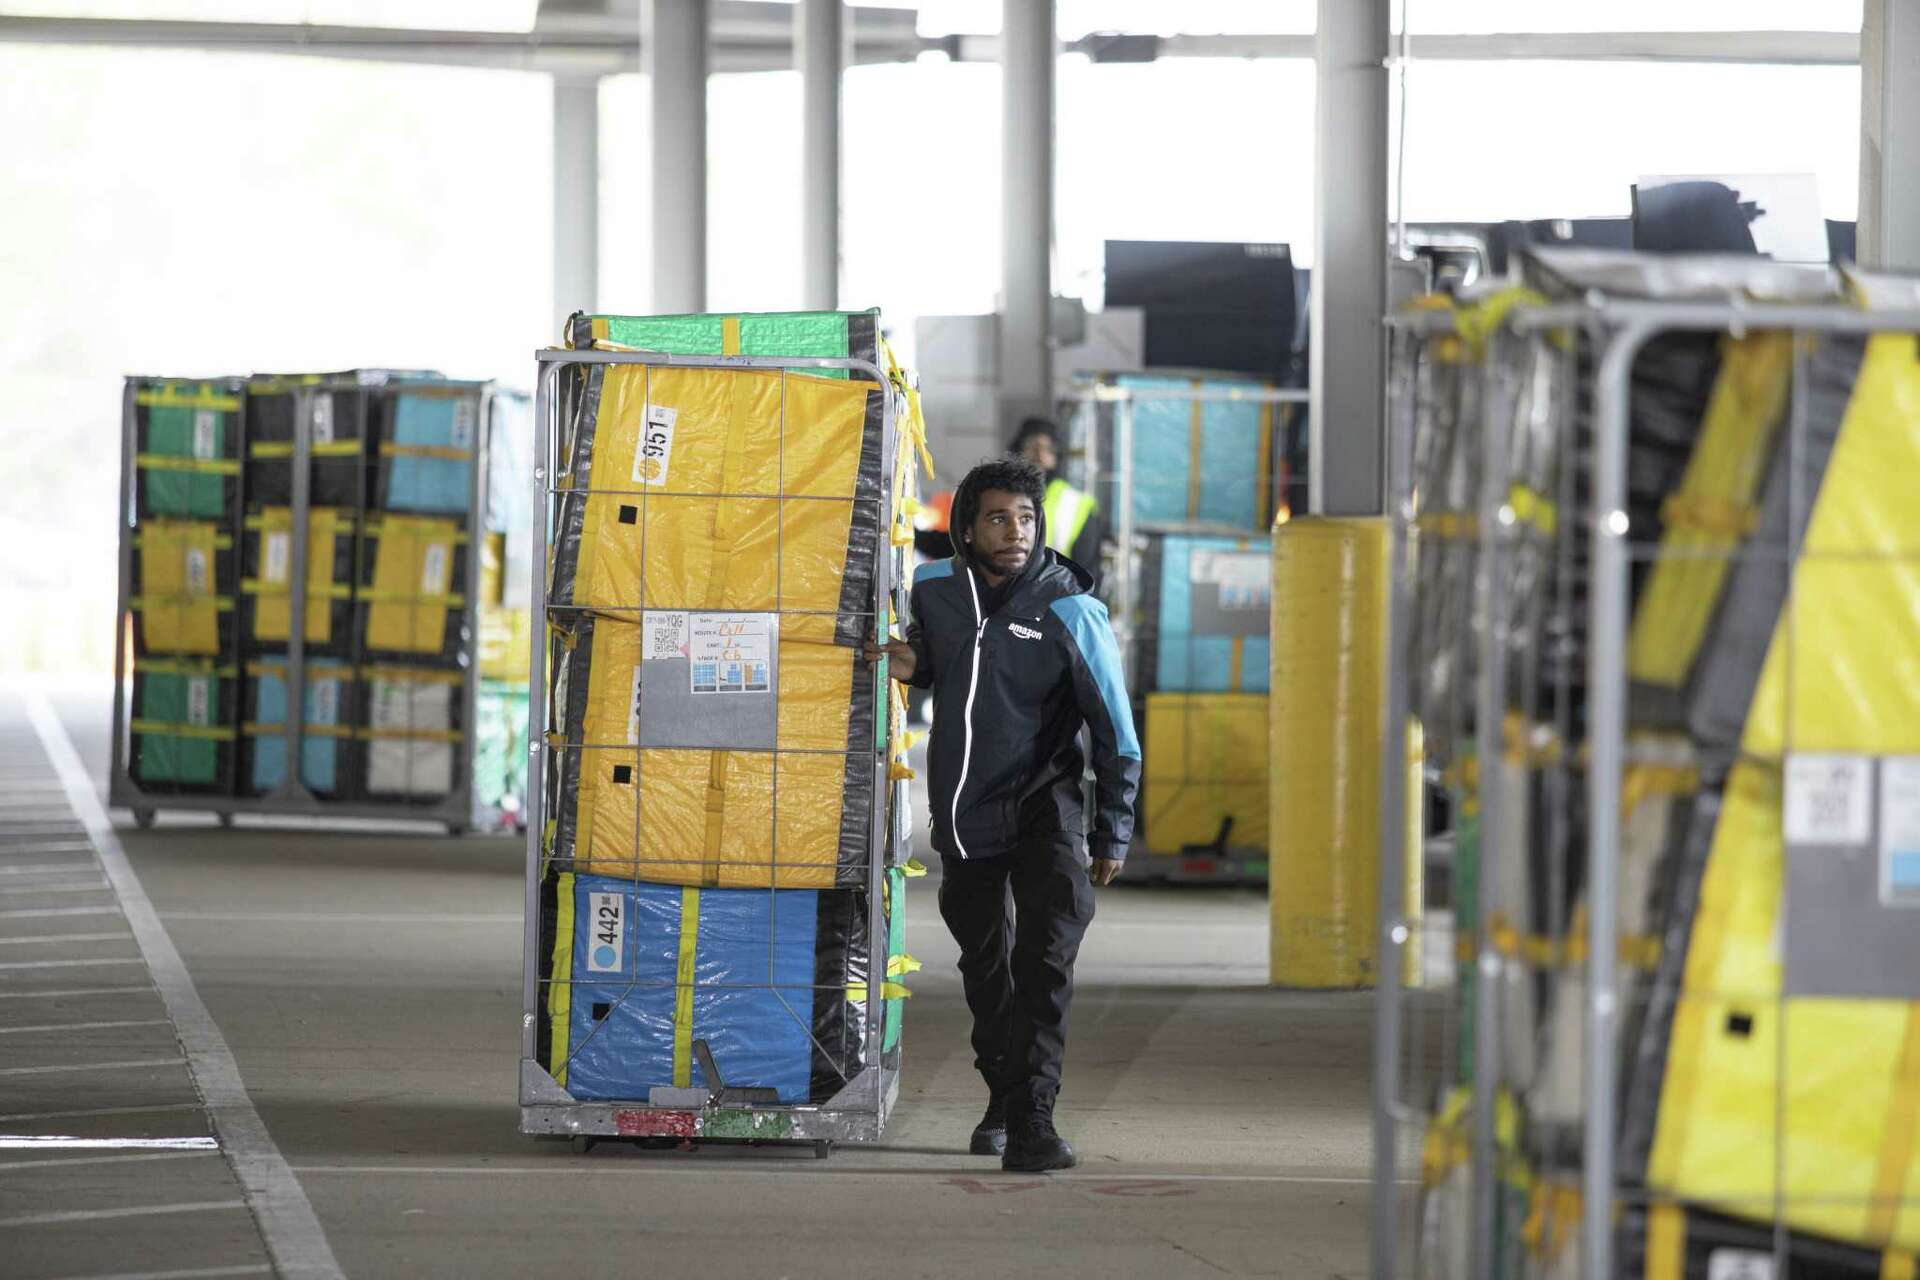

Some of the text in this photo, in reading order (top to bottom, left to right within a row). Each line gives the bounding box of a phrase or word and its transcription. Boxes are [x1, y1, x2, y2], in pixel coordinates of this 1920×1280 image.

[642, 421, 668, 457] 951
[1008, 623, 1042, 640] amazon
[598, 907, 619, 944] 442
